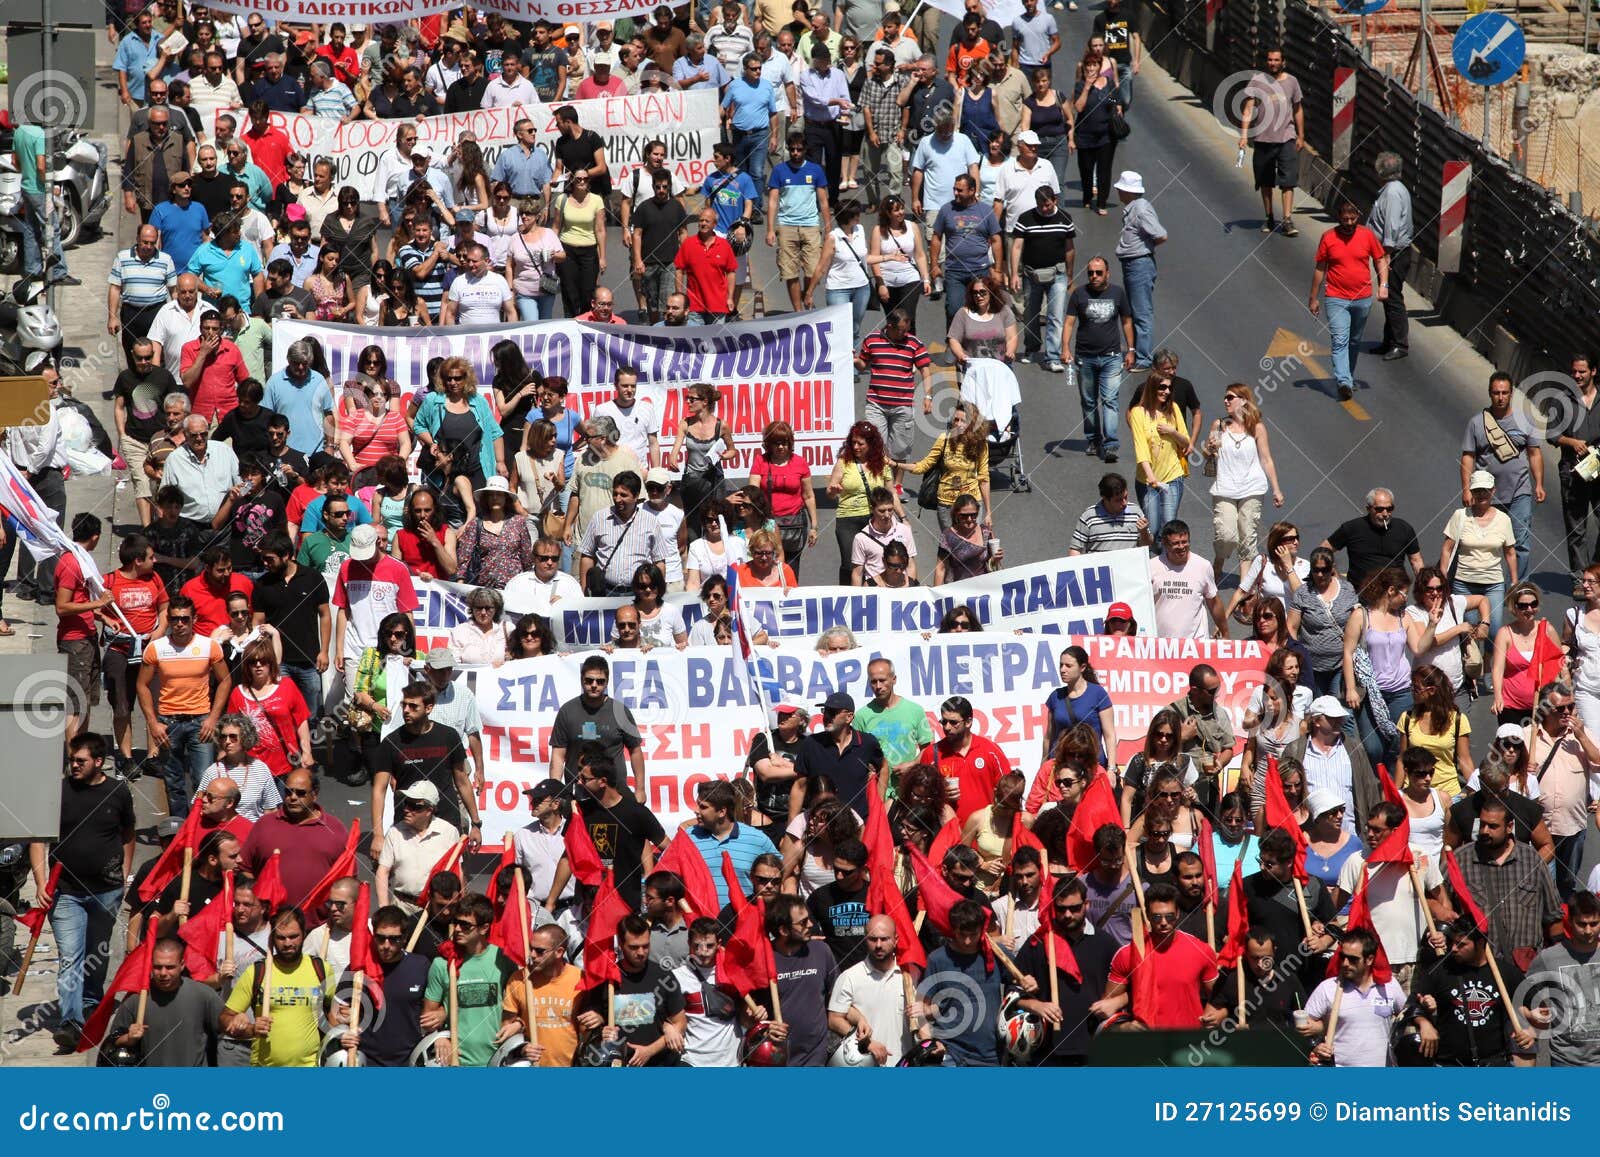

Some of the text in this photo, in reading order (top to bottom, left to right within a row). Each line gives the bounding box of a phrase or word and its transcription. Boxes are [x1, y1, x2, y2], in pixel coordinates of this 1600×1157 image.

[298, 0, 414, 16] ΙΔΙΩΤΙΚΩΝ
[528, 3, 548, 16] Ν.
[605, 92, 685, 128] ΕΝΑΝ
[307, 333, 397, 387] ΤΑΝ
[580, 332, 708, 386] ΓΙΝΕΤΑΙ
[711, 321, 833, 379] ΝΟΜΟΣ
[744, 594, 878, 637] ΑΞΙΚΗ
[1000, 565, 1114, 617] ΠΑΛΗ
[1082, 636, 1263, 660] ΓΡΑΜΜΑΤΕΙΑ
[496, 673, 561, 713] ΣΤΑ
[580, 659, 666, 710] ΕΑ
[686, 650, 883, 709] ΒΑΒΑΡΑ
[909, 639, 1062, 697] ΜΕΤΡΑ
